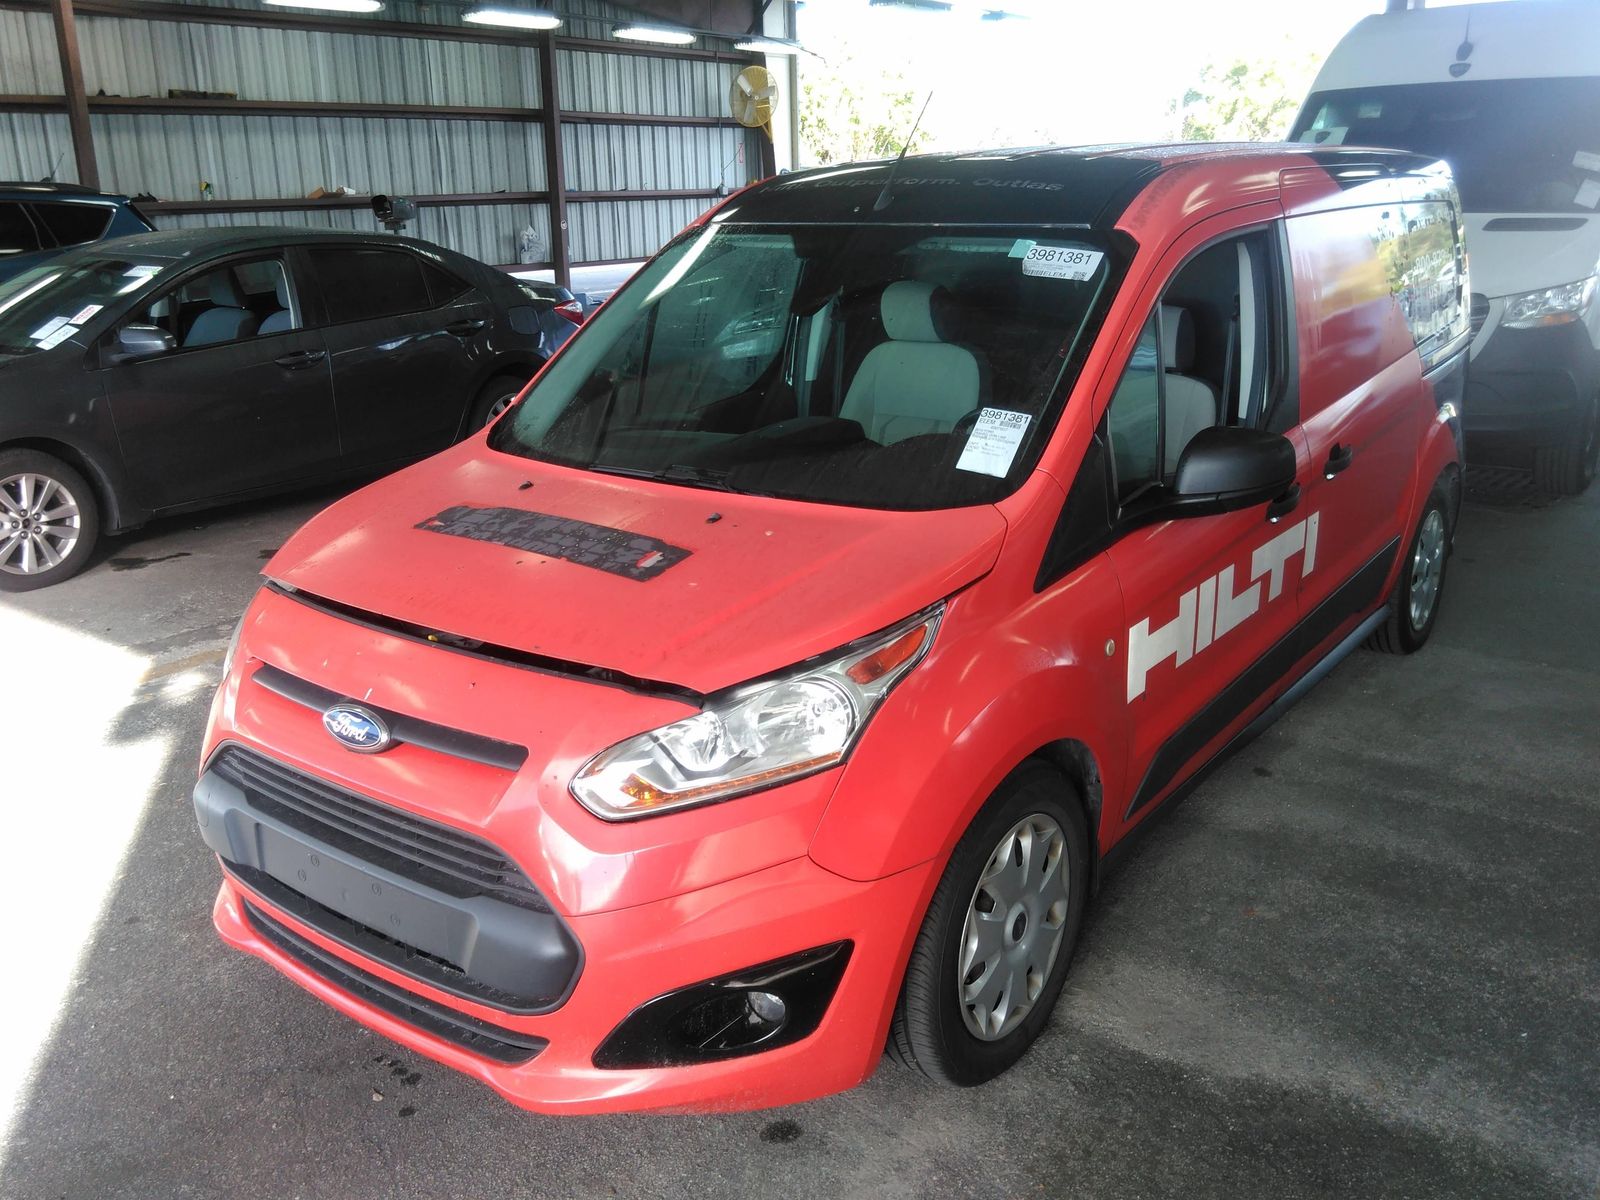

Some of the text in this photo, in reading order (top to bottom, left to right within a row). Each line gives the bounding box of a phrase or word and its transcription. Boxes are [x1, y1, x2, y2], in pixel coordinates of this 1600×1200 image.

[1026, 248, 1092, 265] 3981381
[980, 410, 1029, 424] 3981381
[1126, 511, 1320, 704] HILTI
[330, 712, 370, 742] Ford
